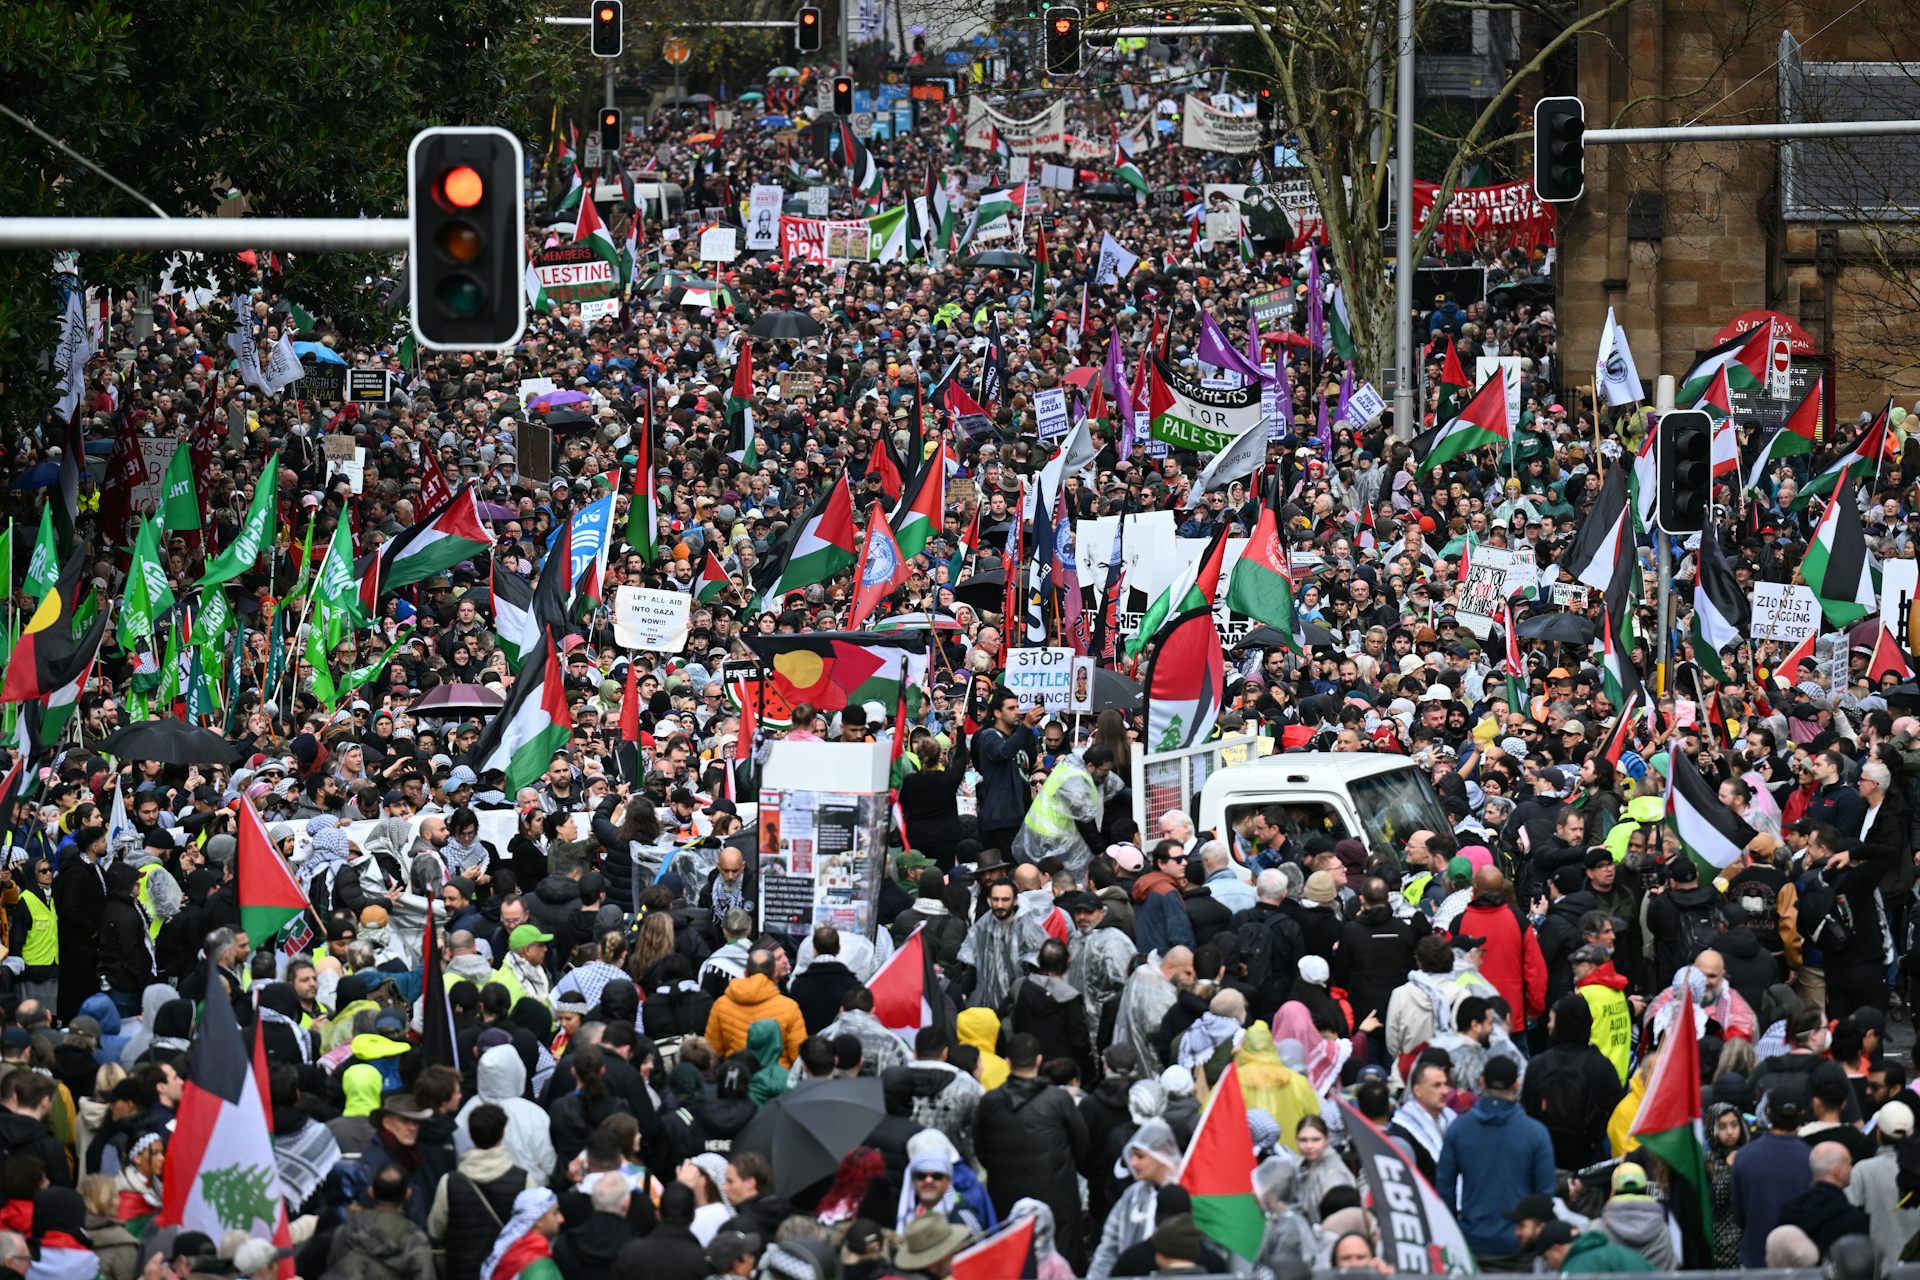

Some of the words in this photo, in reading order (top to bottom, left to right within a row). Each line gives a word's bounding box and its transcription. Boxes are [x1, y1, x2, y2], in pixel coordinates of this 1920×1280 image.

[541, 248, 592, 261] MEMBERS
[541, 262, 612, 285] LESTINE
[1735, 320, 1749, 332] St
[1776, 375, 1786, 384] NO
[306, 388, 335, 400] ISLAM
[1773, 386, 1788, 395] ENTRY
[1041, 397, 1057, 406] FREE
[1356, 396, 1375, 416] GAZA!
[1363, 393, 1376, 408] FREE
[1039, 403, 1062, 414] GAZA!
[1040, 415, 1066, 428] SANCTION
[1189, 404, 1229, 428] FOR
[1041, 423, 1067, 435] ISRAEL
[1491, 570, 1506, 587] YOU
[1757, 596, 1812, 611] ZIONIST
[631, 605, 651, 613] INTO
[653, 608, 675, 616] GAZA
[641, 617, 666, 626] NOW!!!
[1753, 623, 1778, 635] FREE
[1018, 651, 1064, 666] STOP
[725, 668, 757, 678] FREE
[1011, 672, 1071, 687] SETTLER
[1016, 692, 1070, 704] IOLNCE
[704, 1139, 732, 1152] HERE
[1373, 1153, 1430, 1275] FREE
